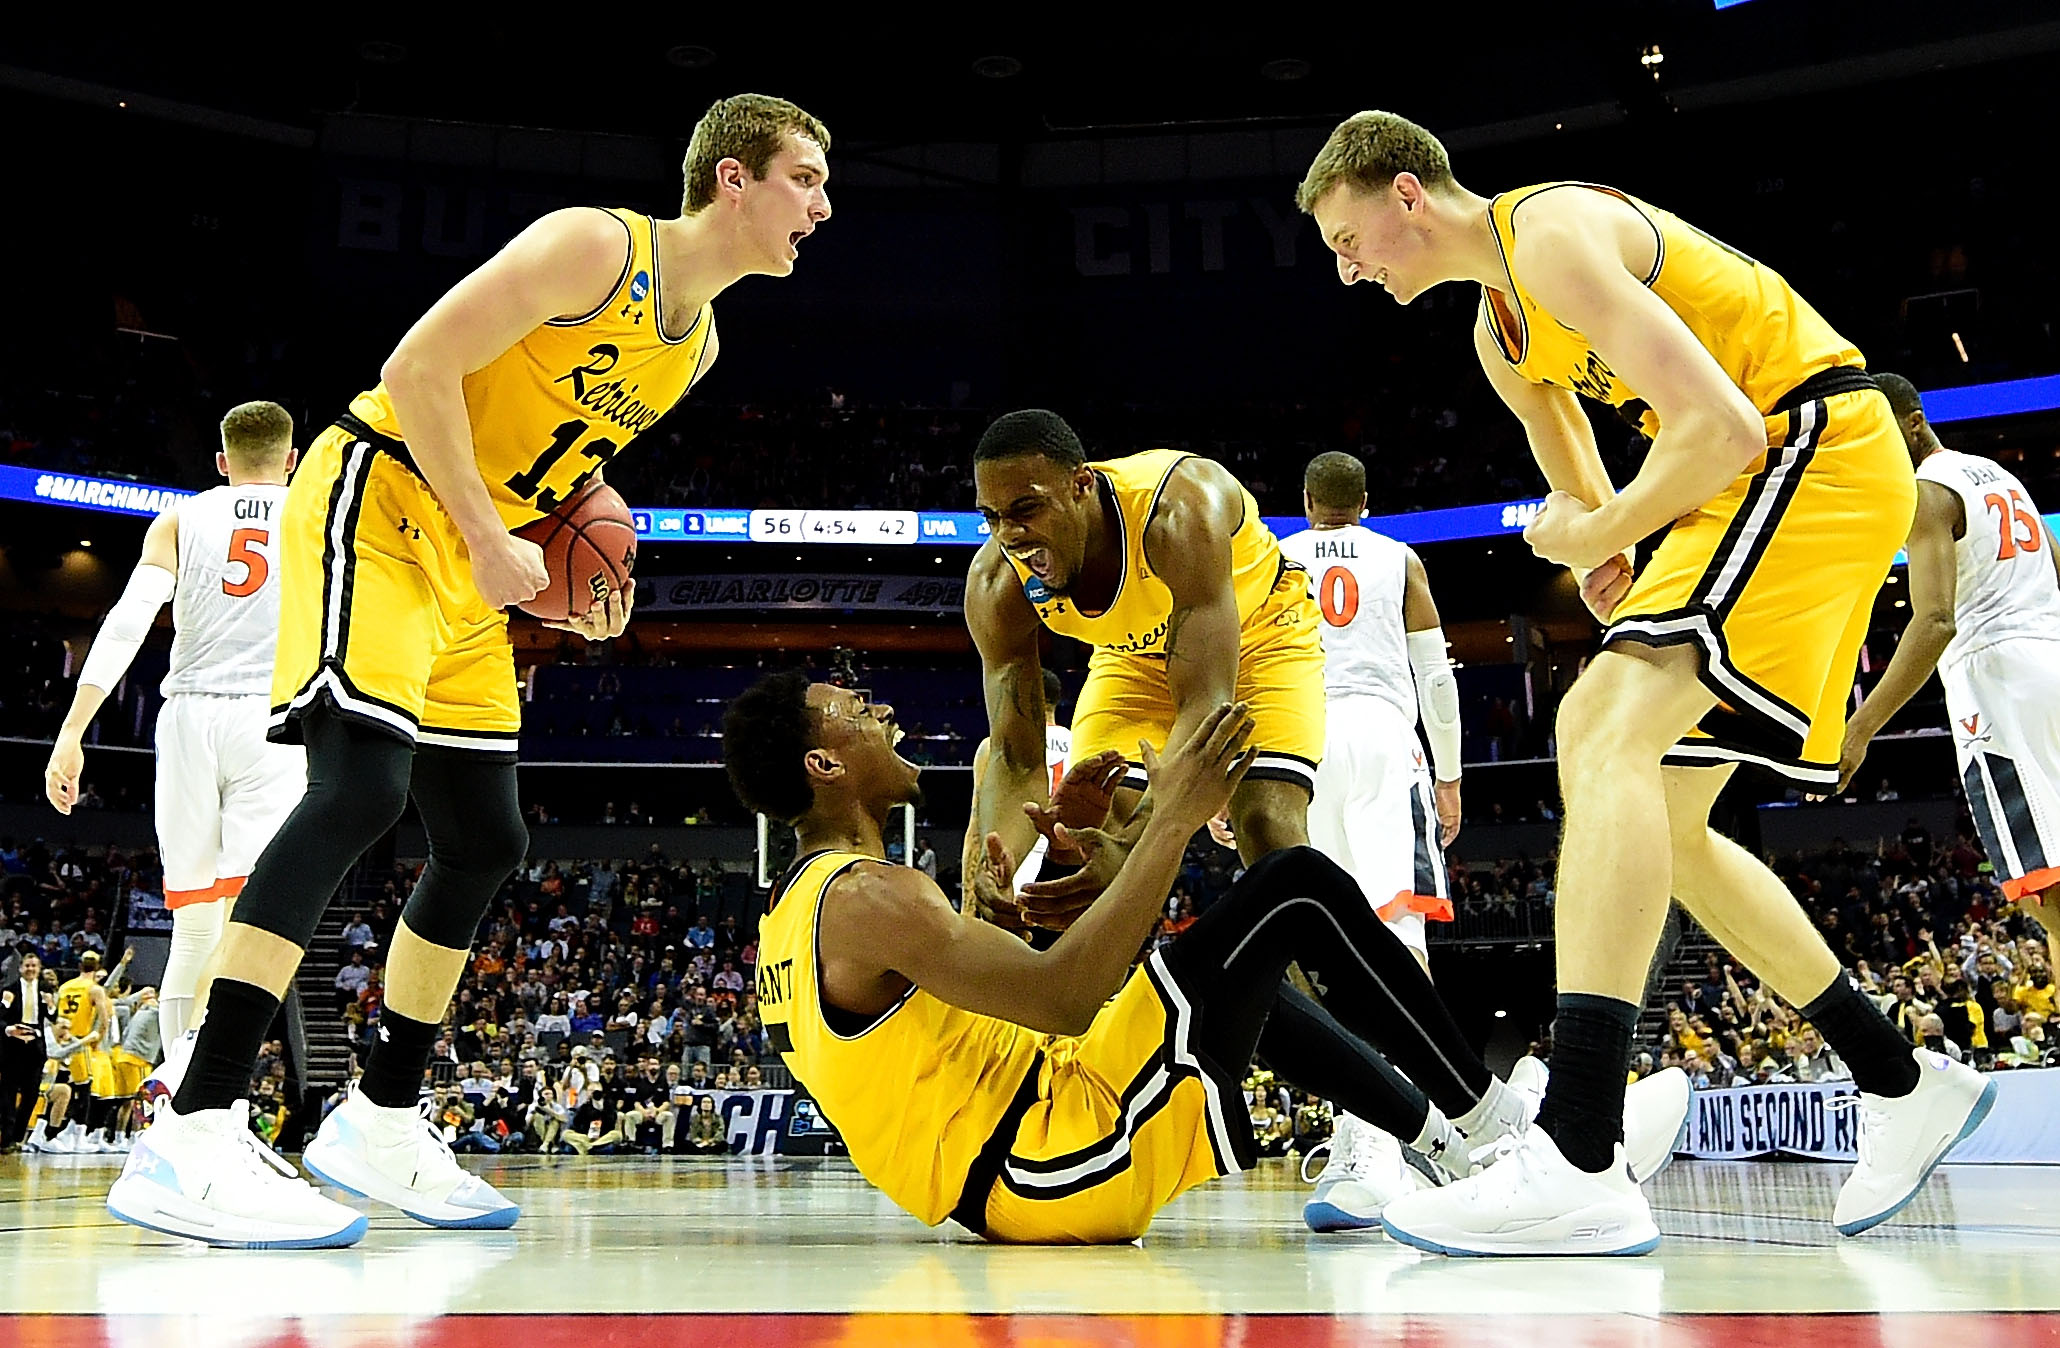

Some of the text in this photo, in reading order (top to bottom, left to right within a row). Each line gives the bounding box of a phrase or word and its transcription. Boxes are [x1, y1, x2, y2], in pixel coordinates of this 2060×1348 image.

[1070, 196, 1305, 277] CITY
[504, 418, 618, 514] 13
[234, 498, 273, 522] GUY
[764, 517, 792, 535] 56
[813, 519, 858, 536] 4:54
[879, 519, 906, 536] 42
[923, 519, 958, 536] UVA
[1984, 488, 2041, 562] 25
[222, 528, 269, 598] 5
[1315, 541, 1359, 559] HALL
[669, 579, 883, 605] CHARLOTTE
[1319, 565, 1360, 628] 0
[1046, 738, 1069, 753] INS
[1699, 1094, 1735, 1152] AND
[1740, 1090, 1826, 1152] SECOND
